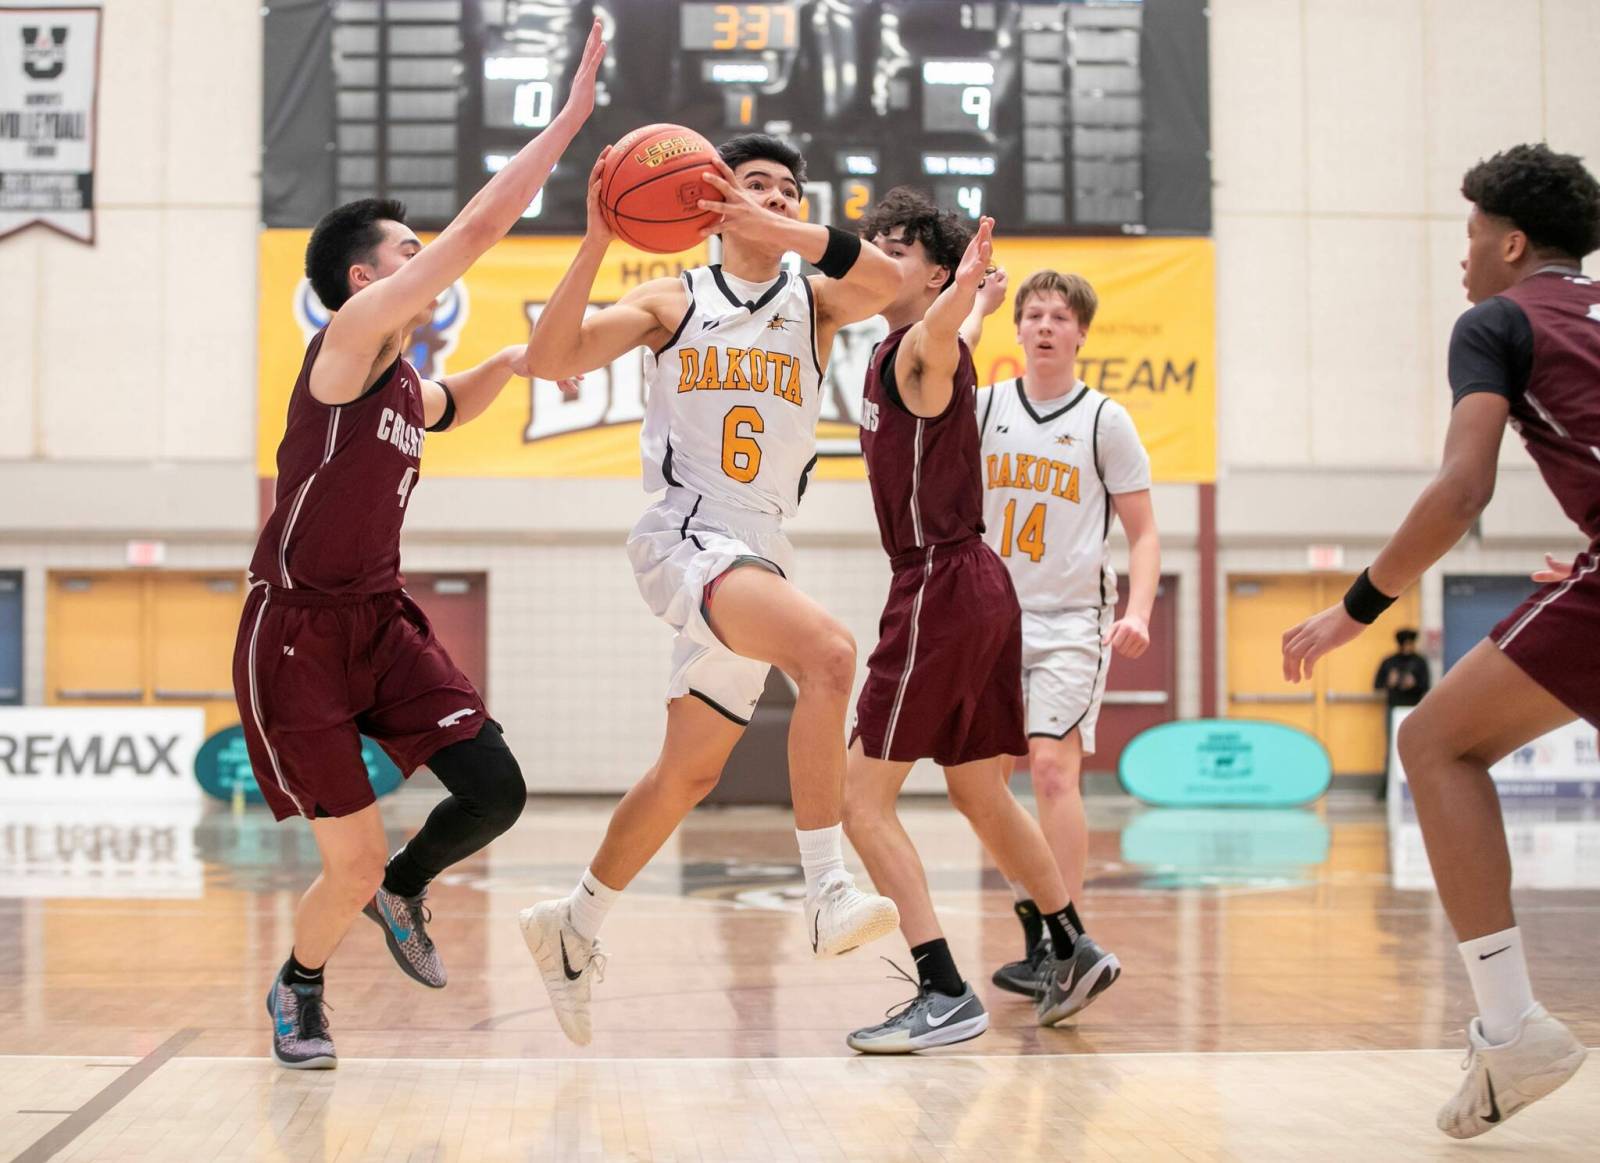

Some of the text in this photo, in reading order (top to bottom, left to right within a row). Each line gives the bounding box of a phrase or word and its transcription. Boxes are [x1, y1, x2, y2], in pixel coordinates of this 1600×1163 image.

[713, 4, 796, 51] 3:37
[513, 81, 553, 127] 10
[961, 86, 991, 130] 9
[844, 184, 870, 220] 2
[958, 187, 982, 219] 4
[677, 345, 804, 407] DAKOTA
[720, 405, 765, 484] 6
[396, 466, 418, 508] 4
[987, 453, 1081, 504] DAKOTA
[1000, 498, 1047, 563] 14
